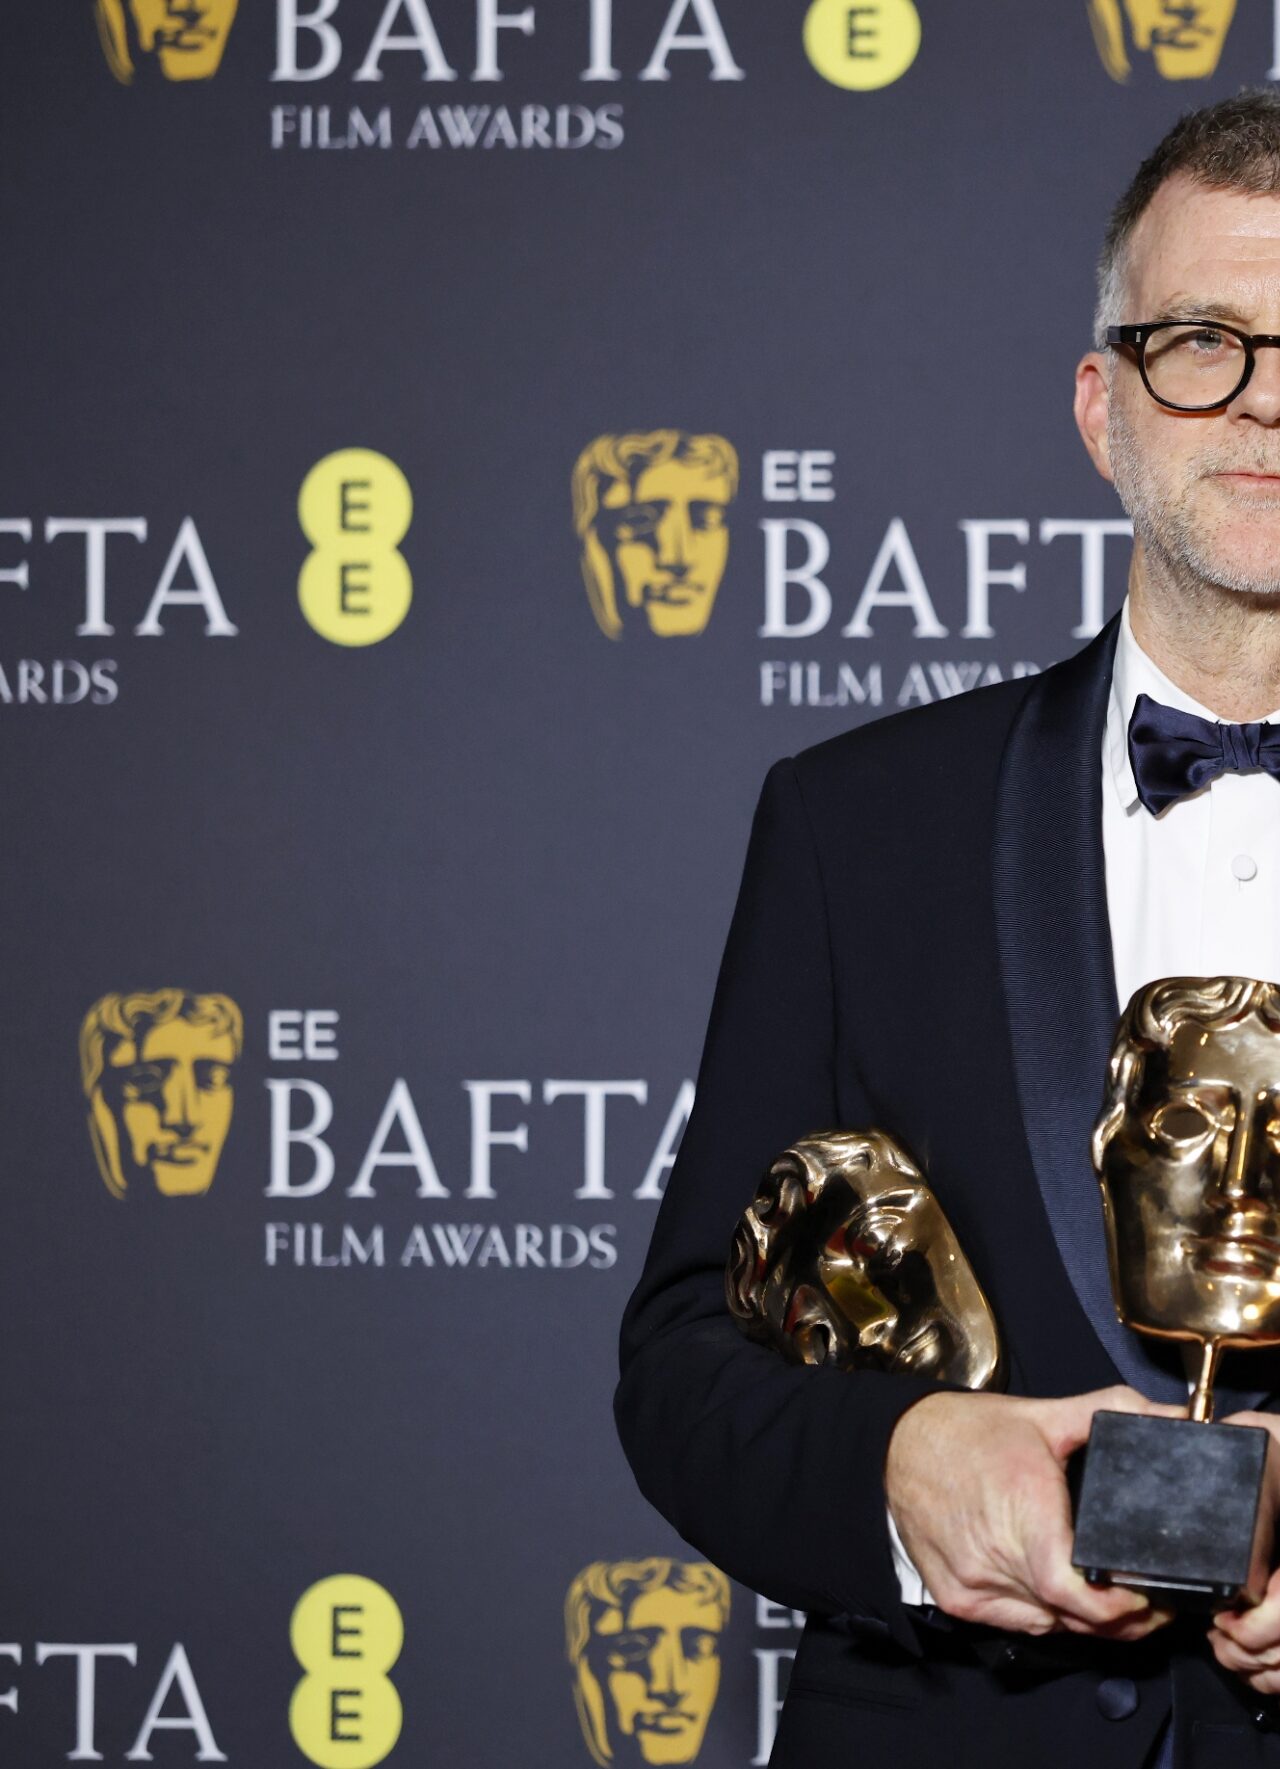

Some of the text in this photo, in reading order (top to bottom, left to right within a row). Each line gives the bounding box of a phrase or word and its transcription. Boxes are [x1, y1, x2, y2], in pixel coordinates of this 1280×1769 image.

[271, 104, 625, 149] FILM AWARDS
[762, 450, 836, 502] EE
[760, 660, 883, 706] FILM
[268, 1009, 340, 1061] EE
[264, 1222, 619, 1269] FILM AWARDS
